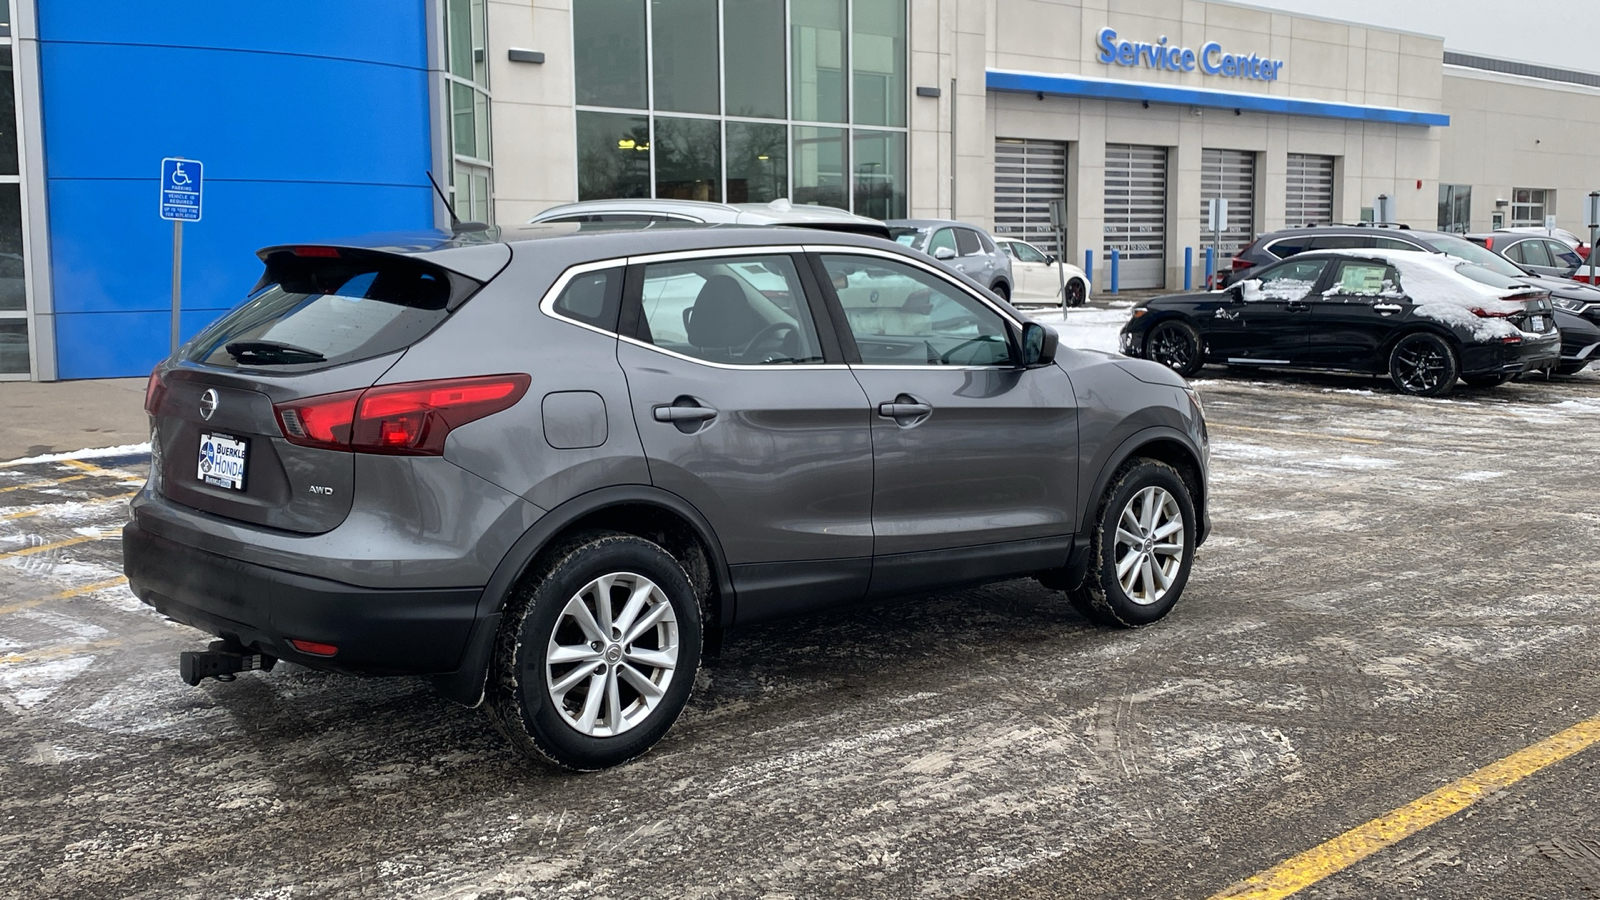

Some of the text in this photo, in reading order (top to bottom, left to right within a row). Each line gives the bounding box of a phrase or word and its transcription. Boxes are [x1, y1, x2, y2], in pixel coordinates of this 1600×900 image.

[1096, 27, 1283, 81] Service Center
[216, 443, 246, 459] BUERKLE
[214, 454, 244, 478] HONDA
[308, 485, 334, 495] AWD
